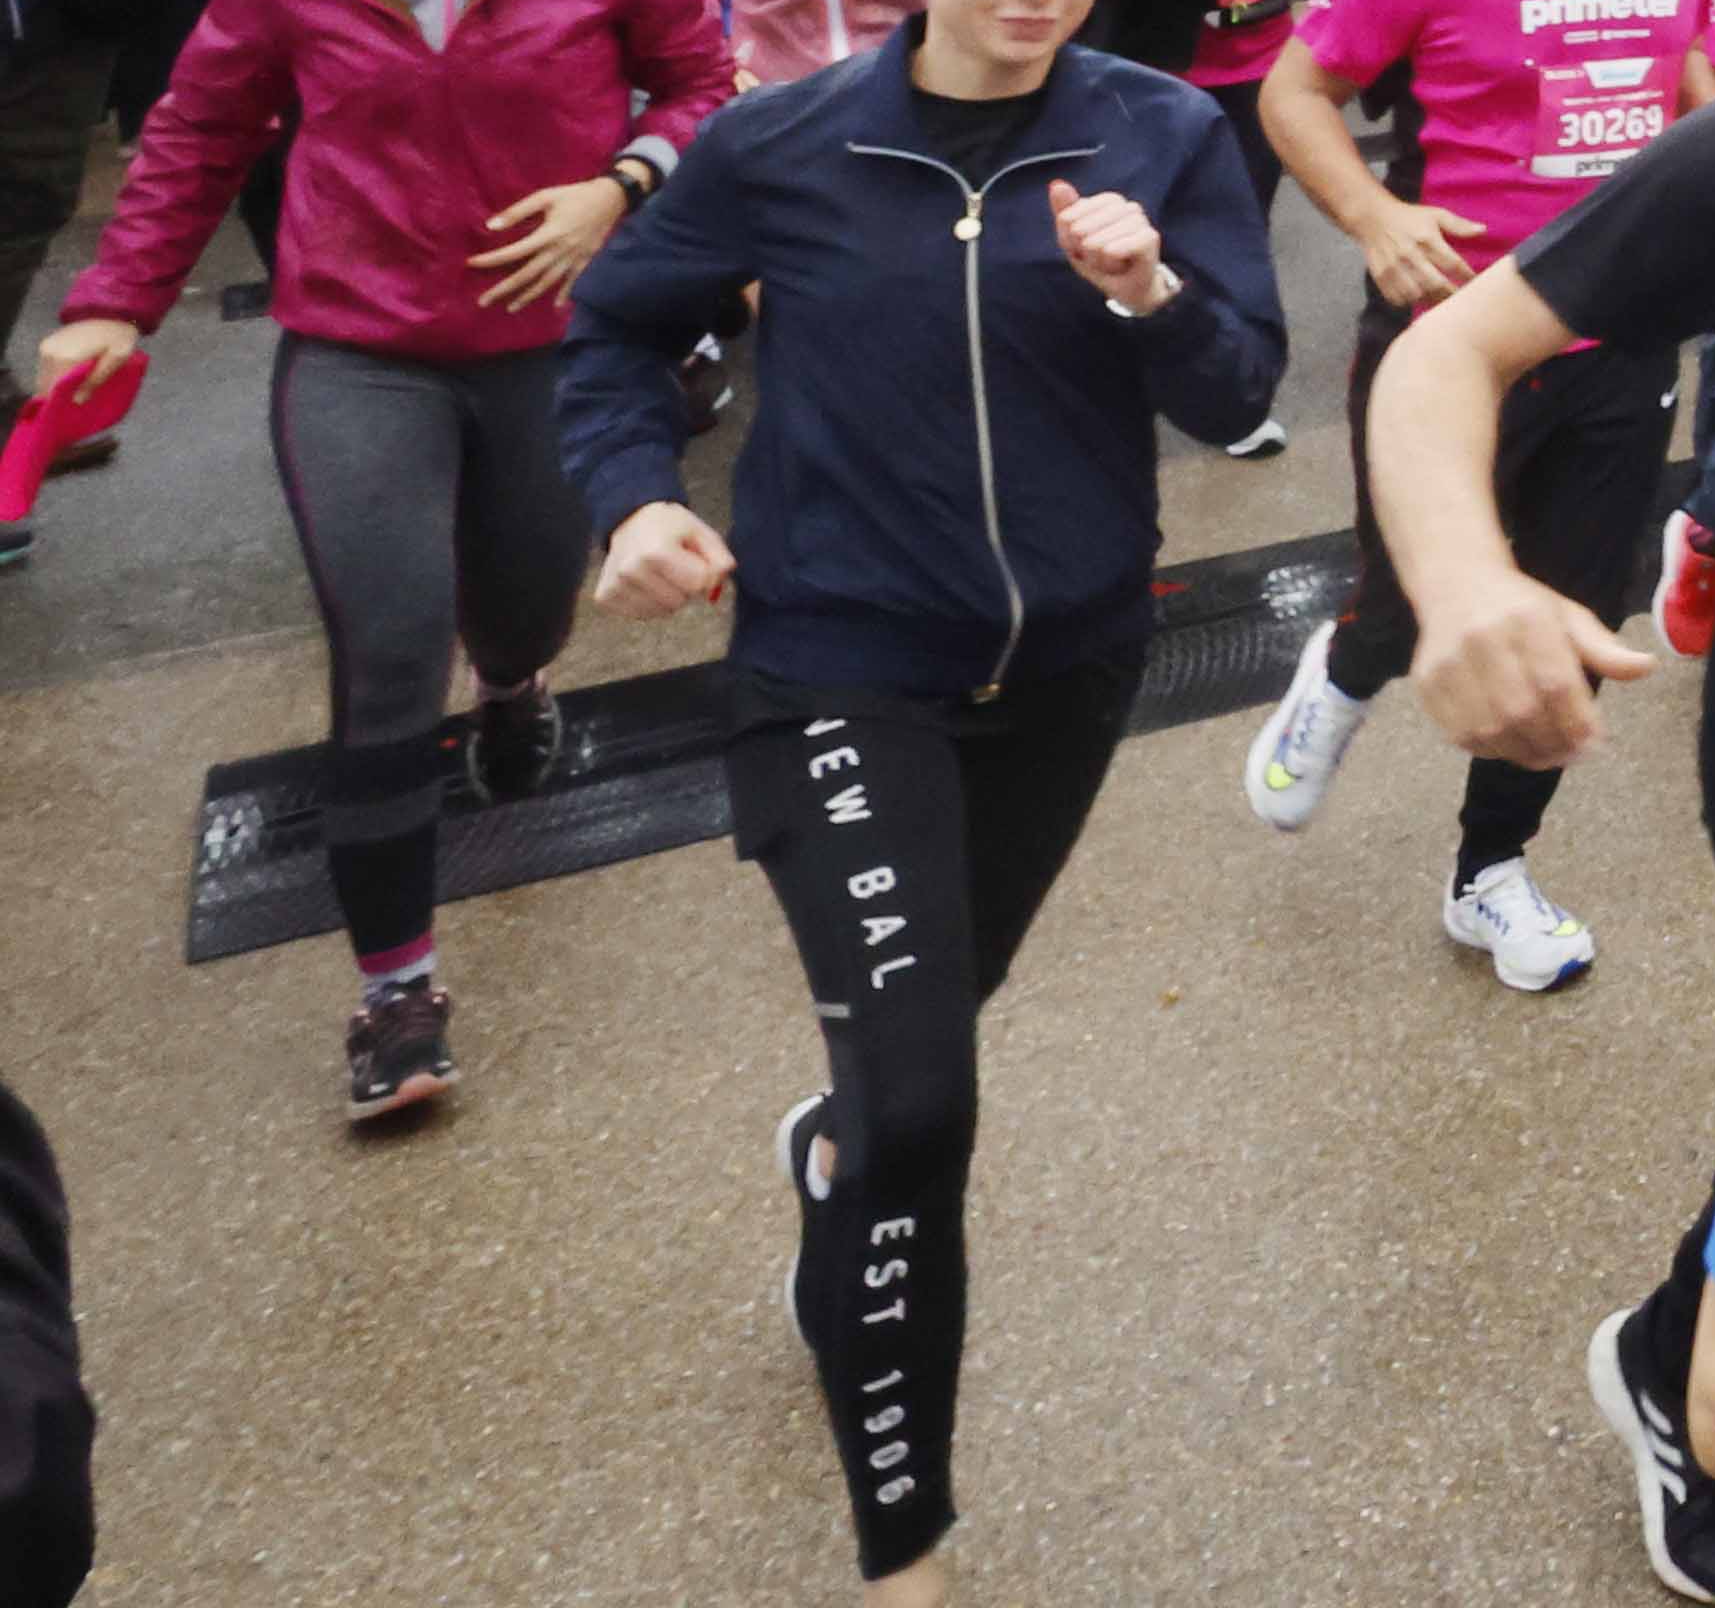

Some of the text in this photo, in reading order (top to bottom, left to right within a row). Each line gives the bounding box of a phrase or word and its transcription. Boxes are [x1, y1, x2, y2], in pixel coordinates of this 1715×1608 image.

[1556, 103, 1664, 148] 30269
[861, 1216, 916, 1505] EST 1906
